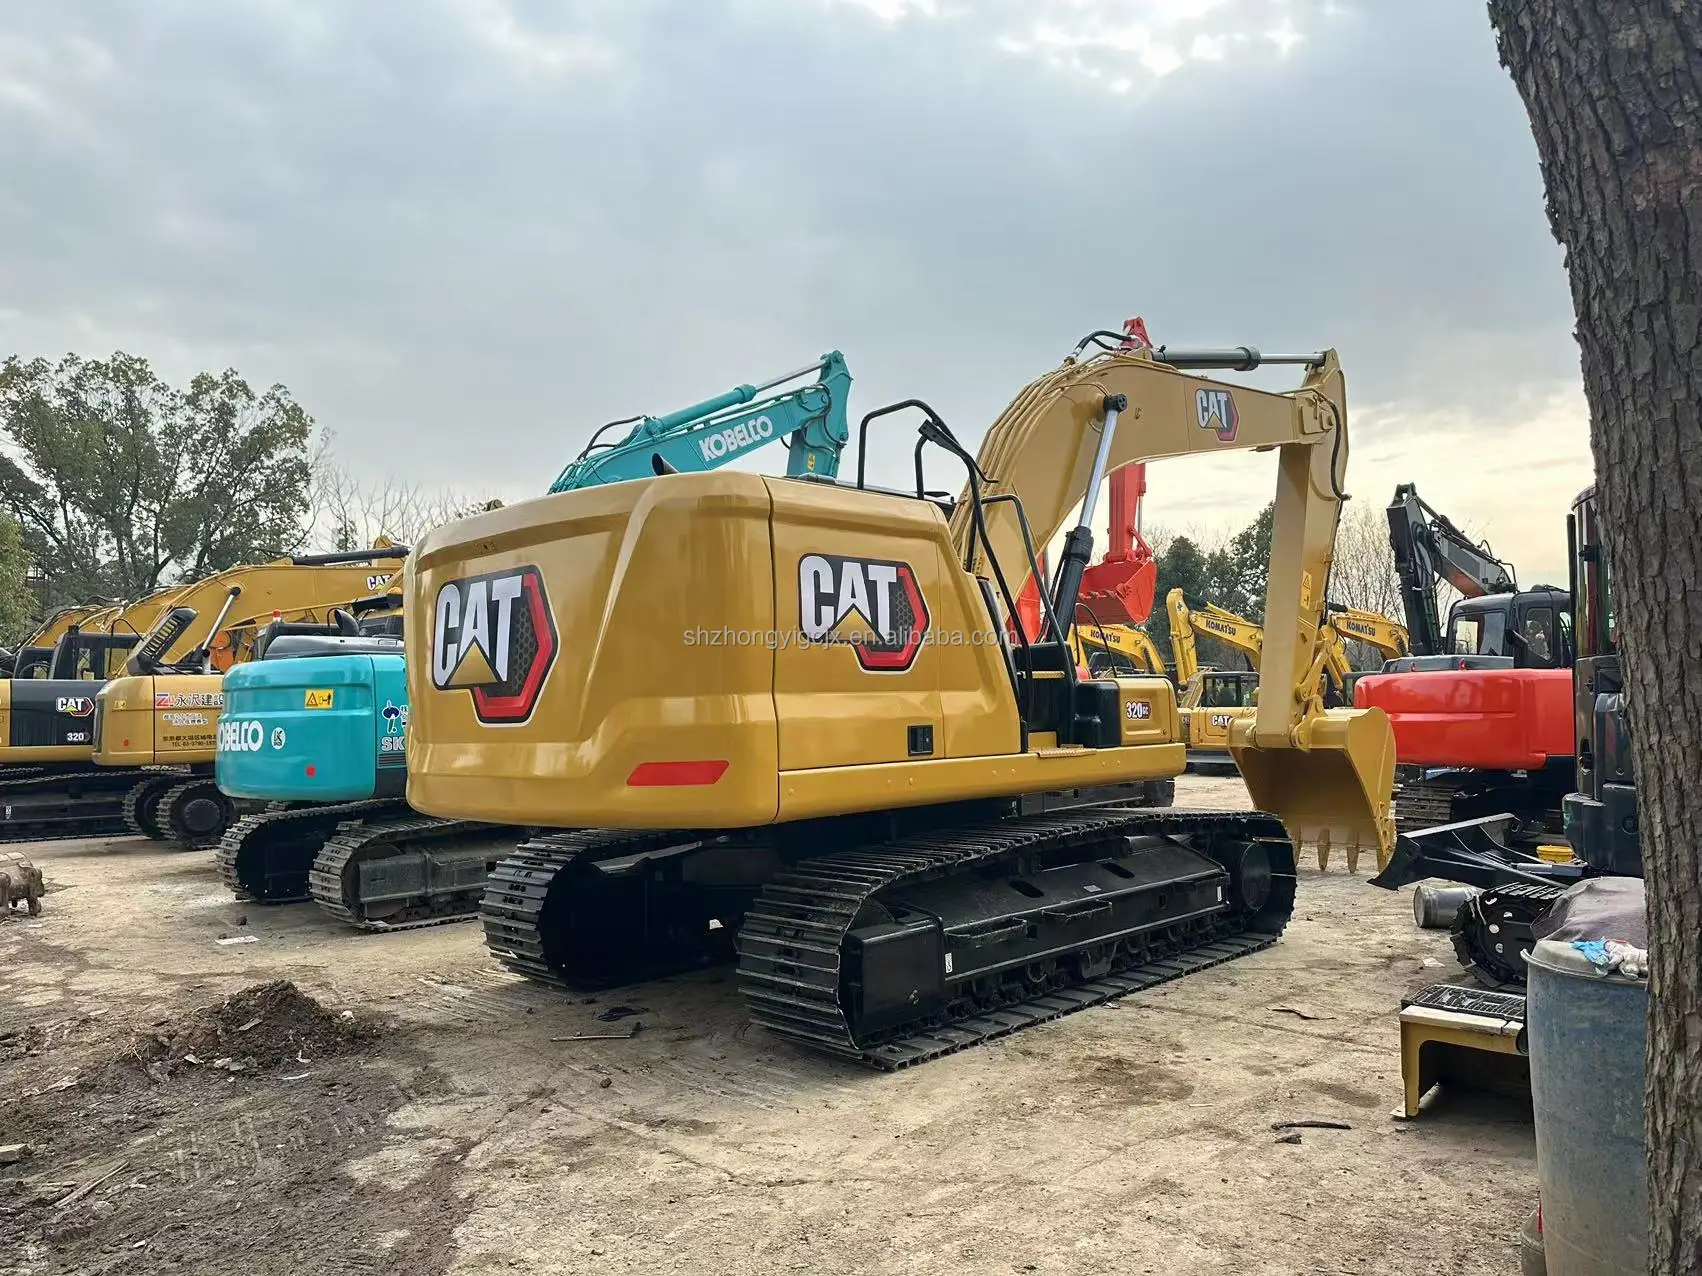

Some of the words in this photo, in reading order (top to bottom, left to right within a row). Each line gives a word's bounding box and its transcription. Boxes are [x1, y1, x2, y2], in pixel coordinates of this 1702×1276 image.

[1196, 389, 1227, 428] CAT
[699, 415, 773, 462] KOBELCO
[366, 574, 390, 591] CAT
[800, 555, 897, 642] CAT
[433, 575, 522, 687] CAT
[1205, 619, 1237, 636] KOMATSU
[1346, 620, 1376, 637] KOMATSU
[57, 697, 85, 712] CAT
[1212, 715, 1229, 726] CAT
[67, 732, 84, 741] 320
[216, 720, 264, 752] OBELCO
